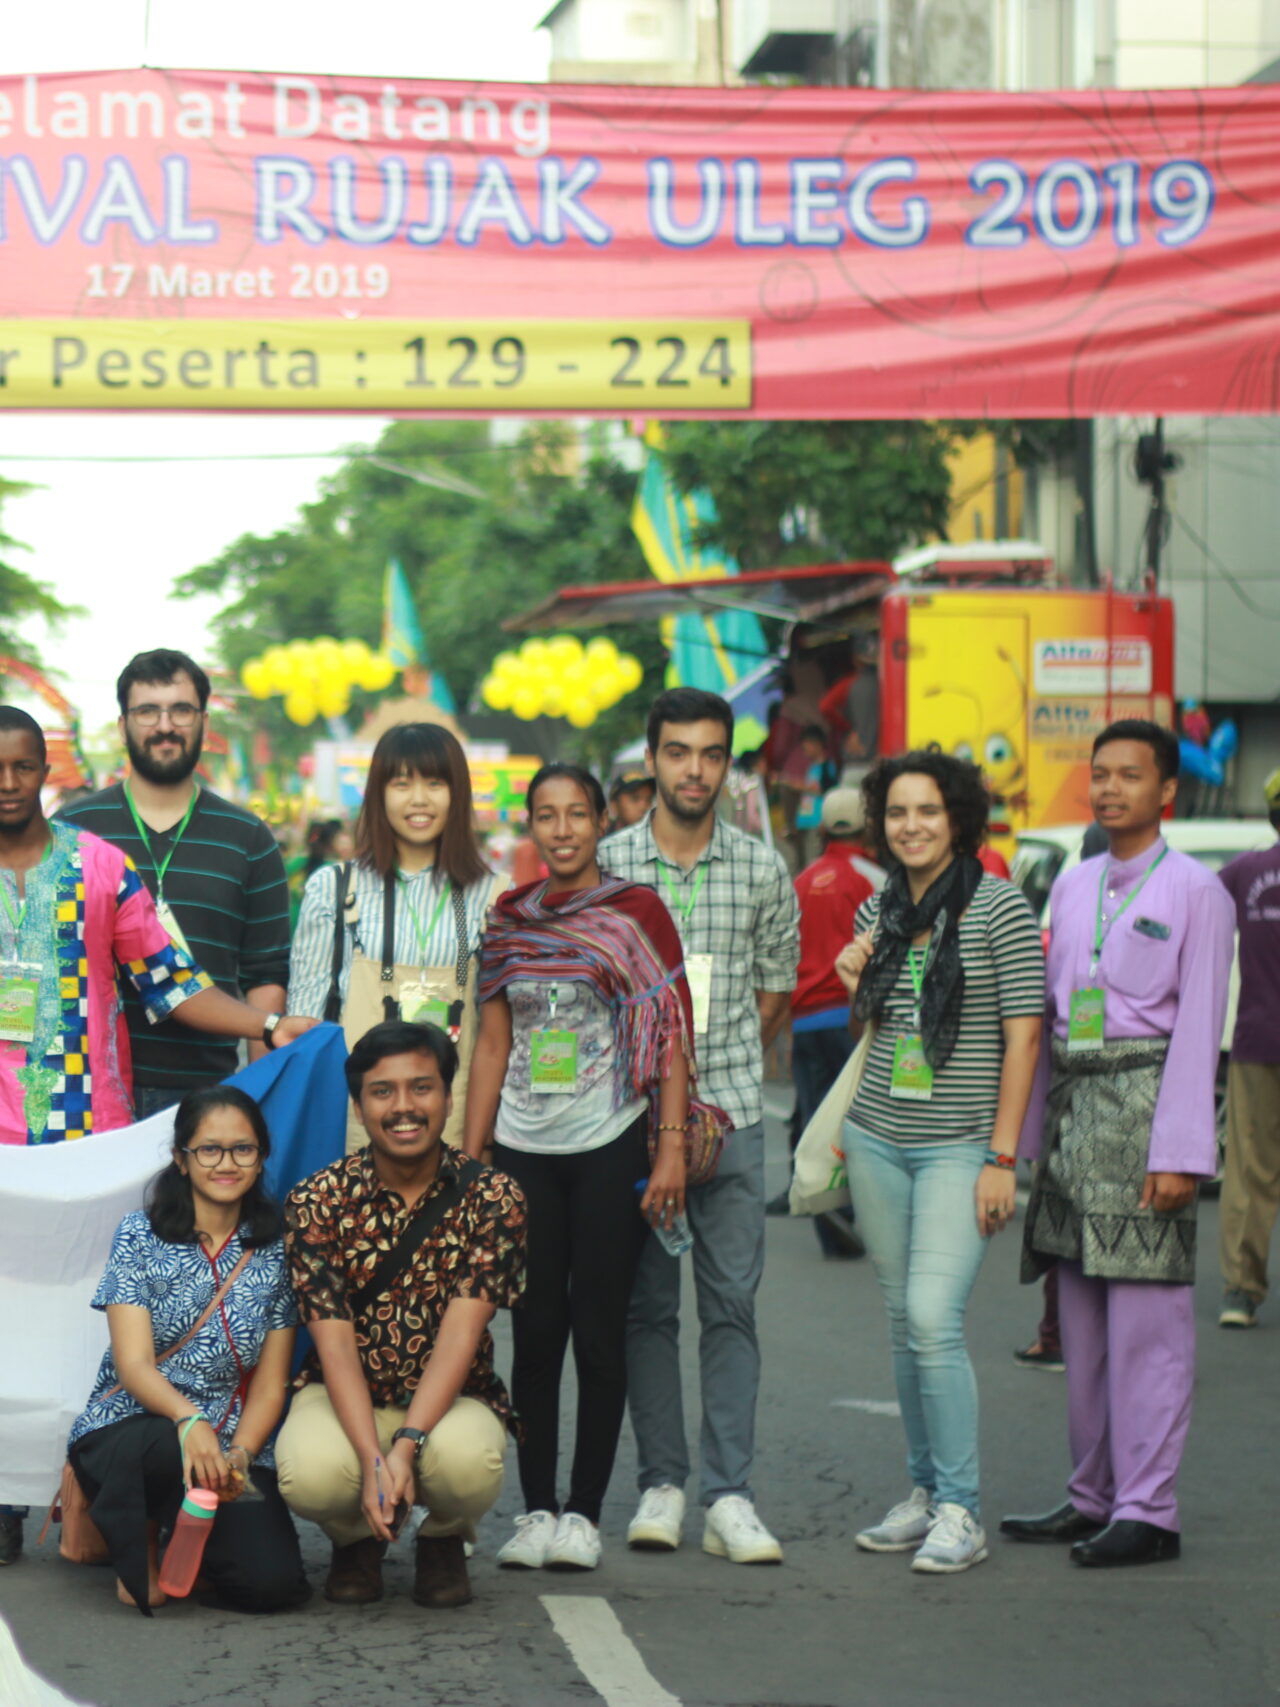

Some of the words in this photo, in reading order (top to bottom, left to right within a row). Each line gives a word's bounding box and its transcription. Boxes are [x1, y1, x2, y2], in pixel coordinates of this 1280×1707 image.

[273, 76, 550, 158] Datang
[252, 155, 612, 247] RUJAK
[647, 155, 928, 248] ULEG
[964, 157, 1216, 248] 2019
[86, 263, 132, 300] 17
[149, 263, 275, 300] Maret
[290, 263, 390, 301] 2019
[52, 335, 321, 390] Peserta
[402, 336, 526, 389] 129
[609, 336, 736, 388] 224
